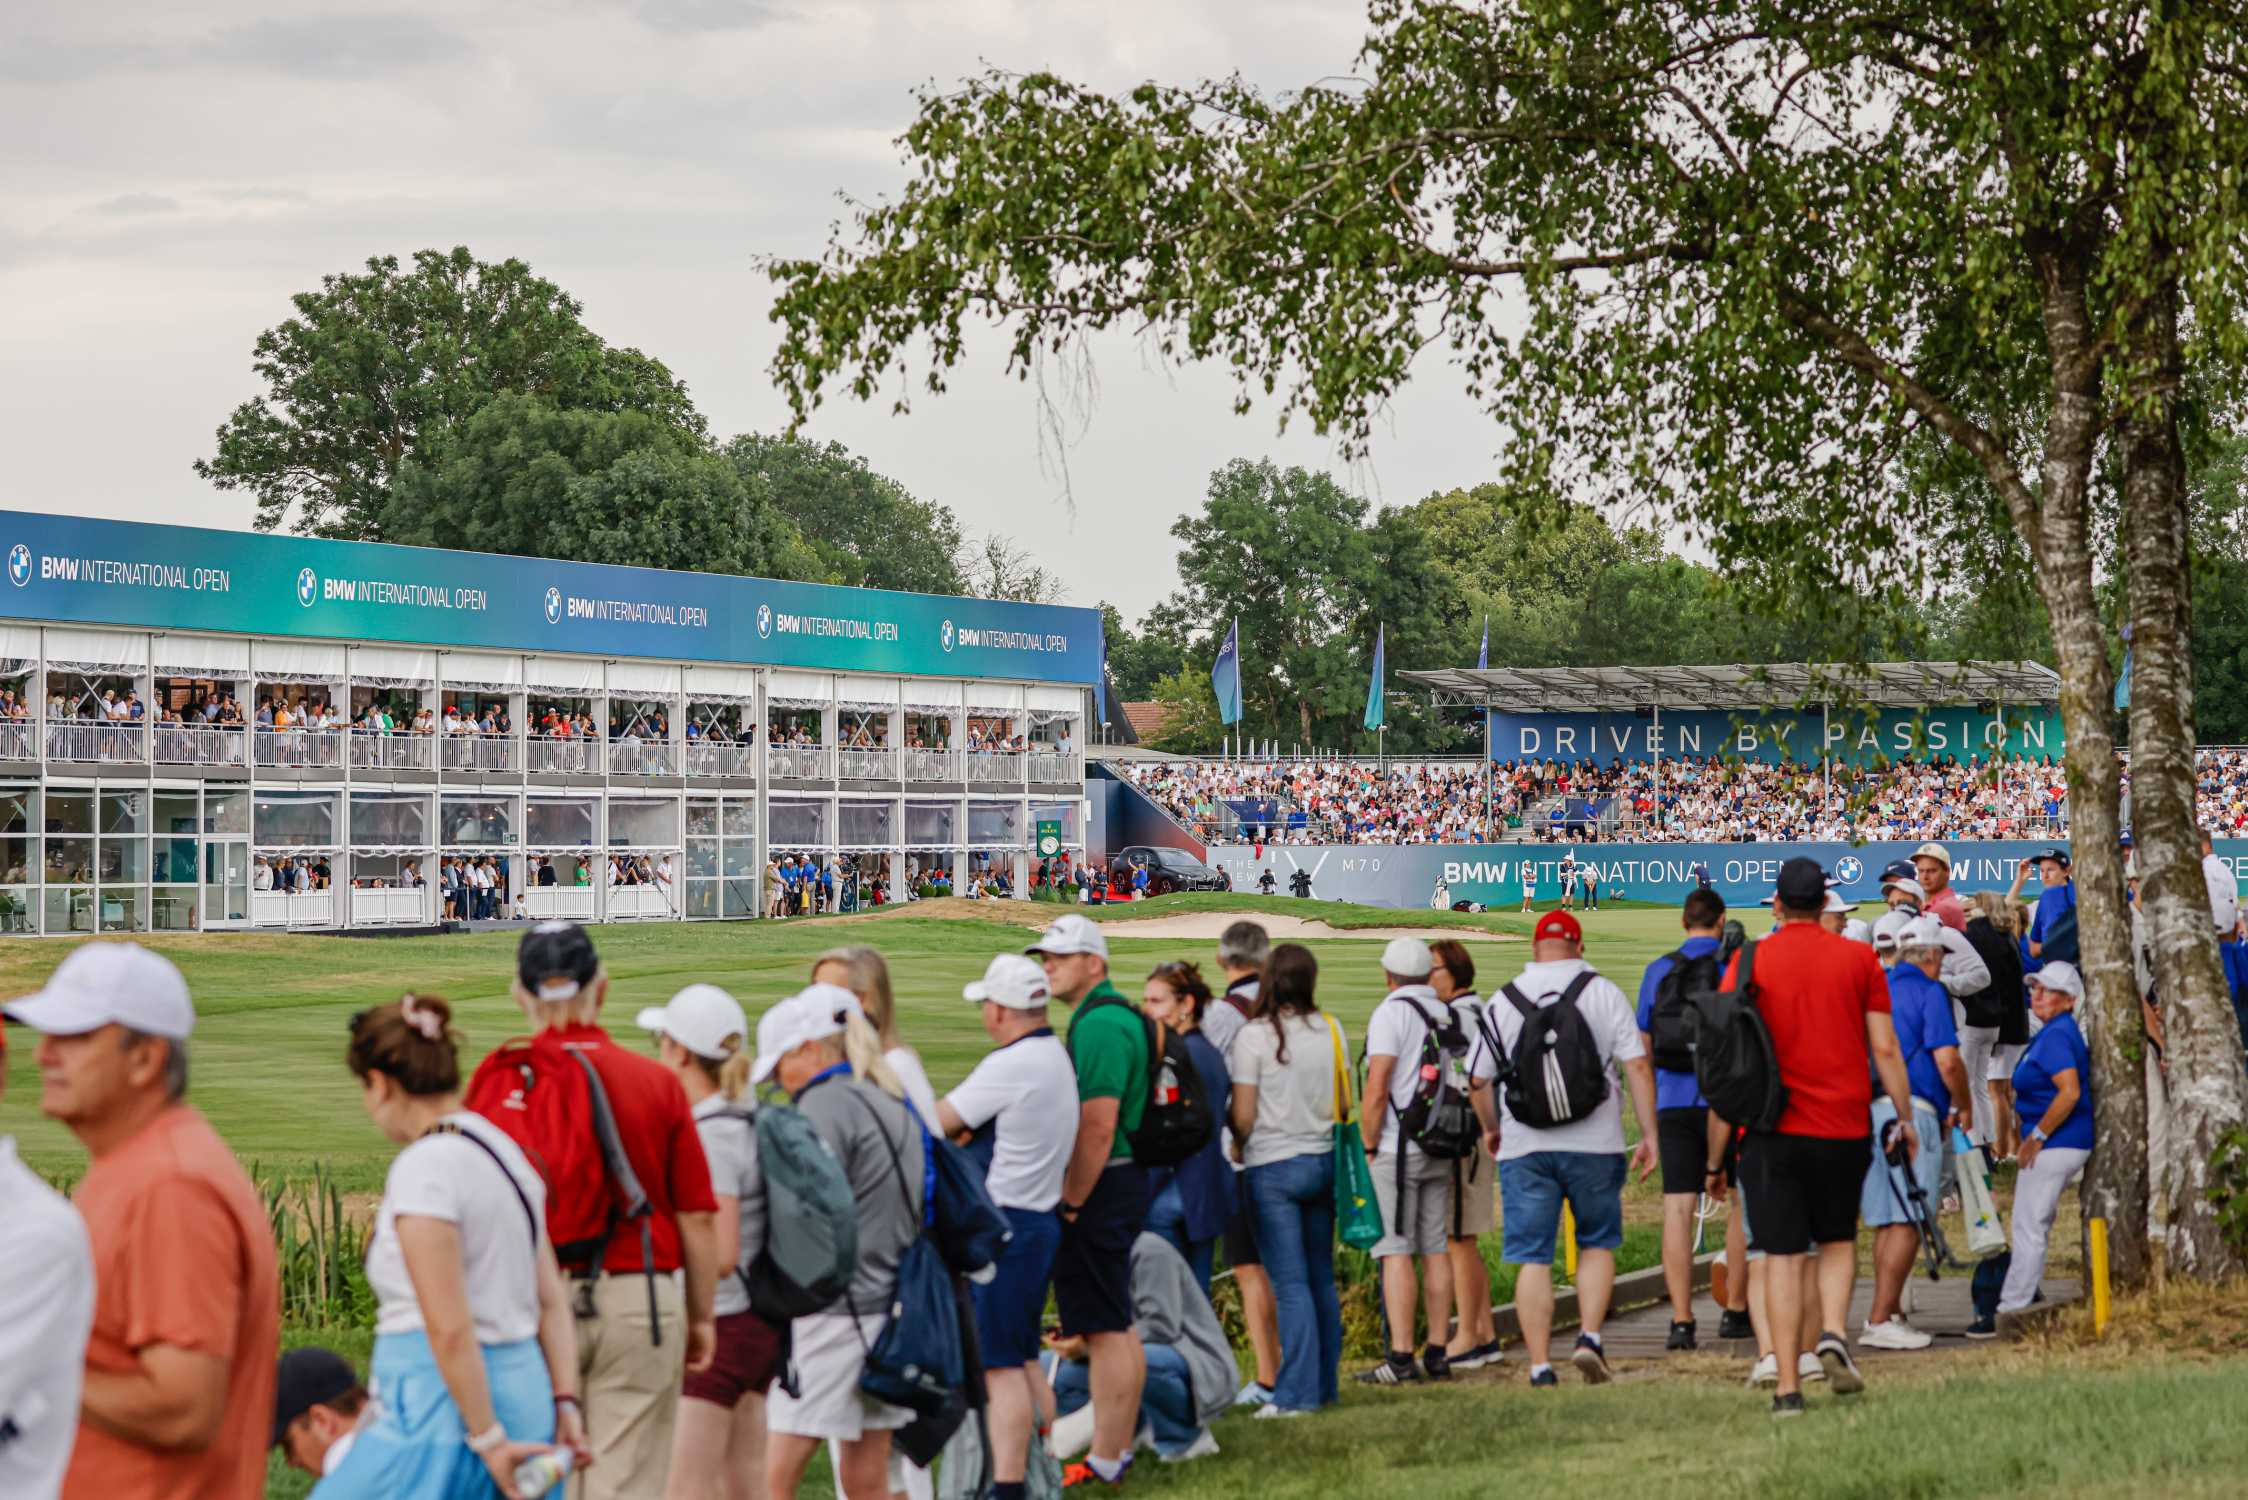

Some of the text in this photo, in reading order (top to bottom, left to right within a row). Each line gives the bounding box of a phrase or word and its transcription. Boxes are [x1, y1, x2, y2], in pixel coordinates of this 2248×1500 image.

[41, 556, 230, 592] BMW INTERNATIONAL OPEN
[324, 578, 487, 610] BMW INTERNATIONAL OPEN
[567, 597, 707, 627] BMW INTERNATIONAL OPEN
[777, 614, 898, 641] BMW INTERNATIONAL OPEN
[959, 628, 1067, 652] BMW INTERNATIONAL OPEN
[1520, 725, 1700, 754] DRIVEN
[1223, 859, 1254, 869] THE
[1230, 872, 1256, 881] EW
[1444, 862, 1507, 883] BMW
[1725, 860, 1786, 882] OPE
